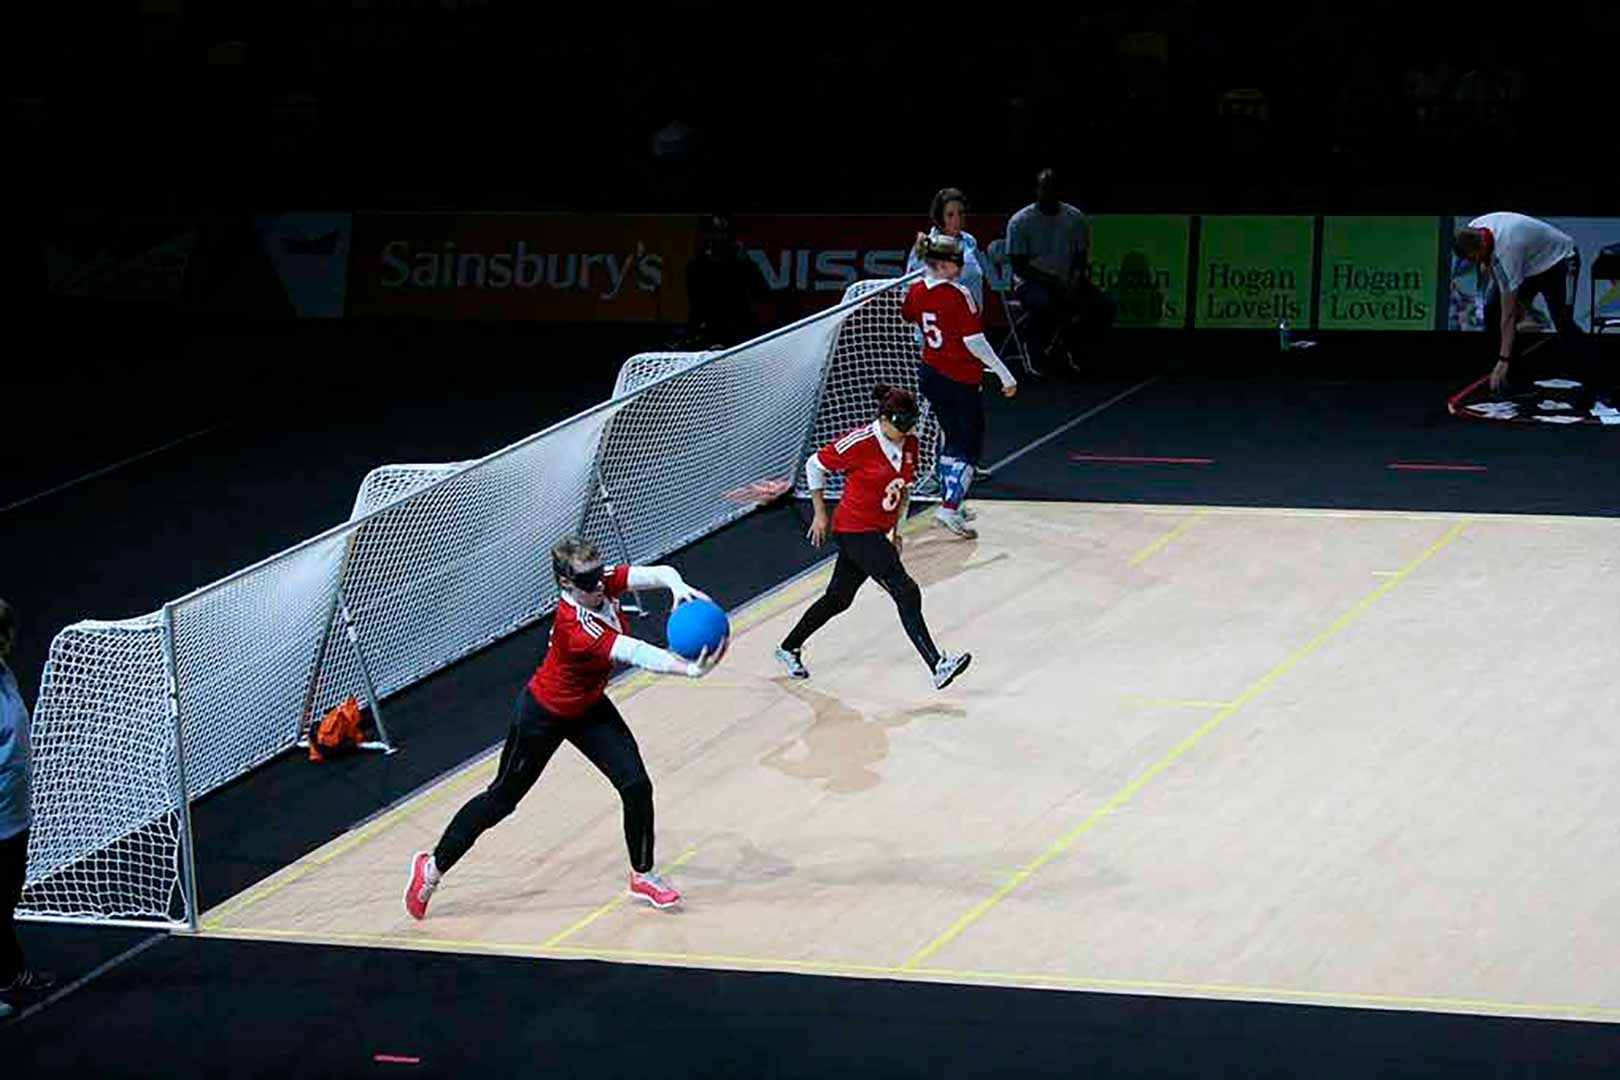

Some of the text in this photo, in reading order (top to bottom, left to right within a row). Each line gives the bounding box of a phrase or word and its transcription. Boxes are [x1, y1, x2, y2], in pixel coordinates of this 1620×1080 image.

[380, 240, 664, 301] Sainsbury's
[740, 247, 915, 294] NISS
[1087, 263, 1170, 293] Hon
[1208, 263, 1297, 295] Hogan
[1333, 263, 1421, 296] Hogan
[1207, 294, 1301, 319] Lovells
[1332, 294, 1428, 321] Lovells
[921, 311, 944, 350] 5
